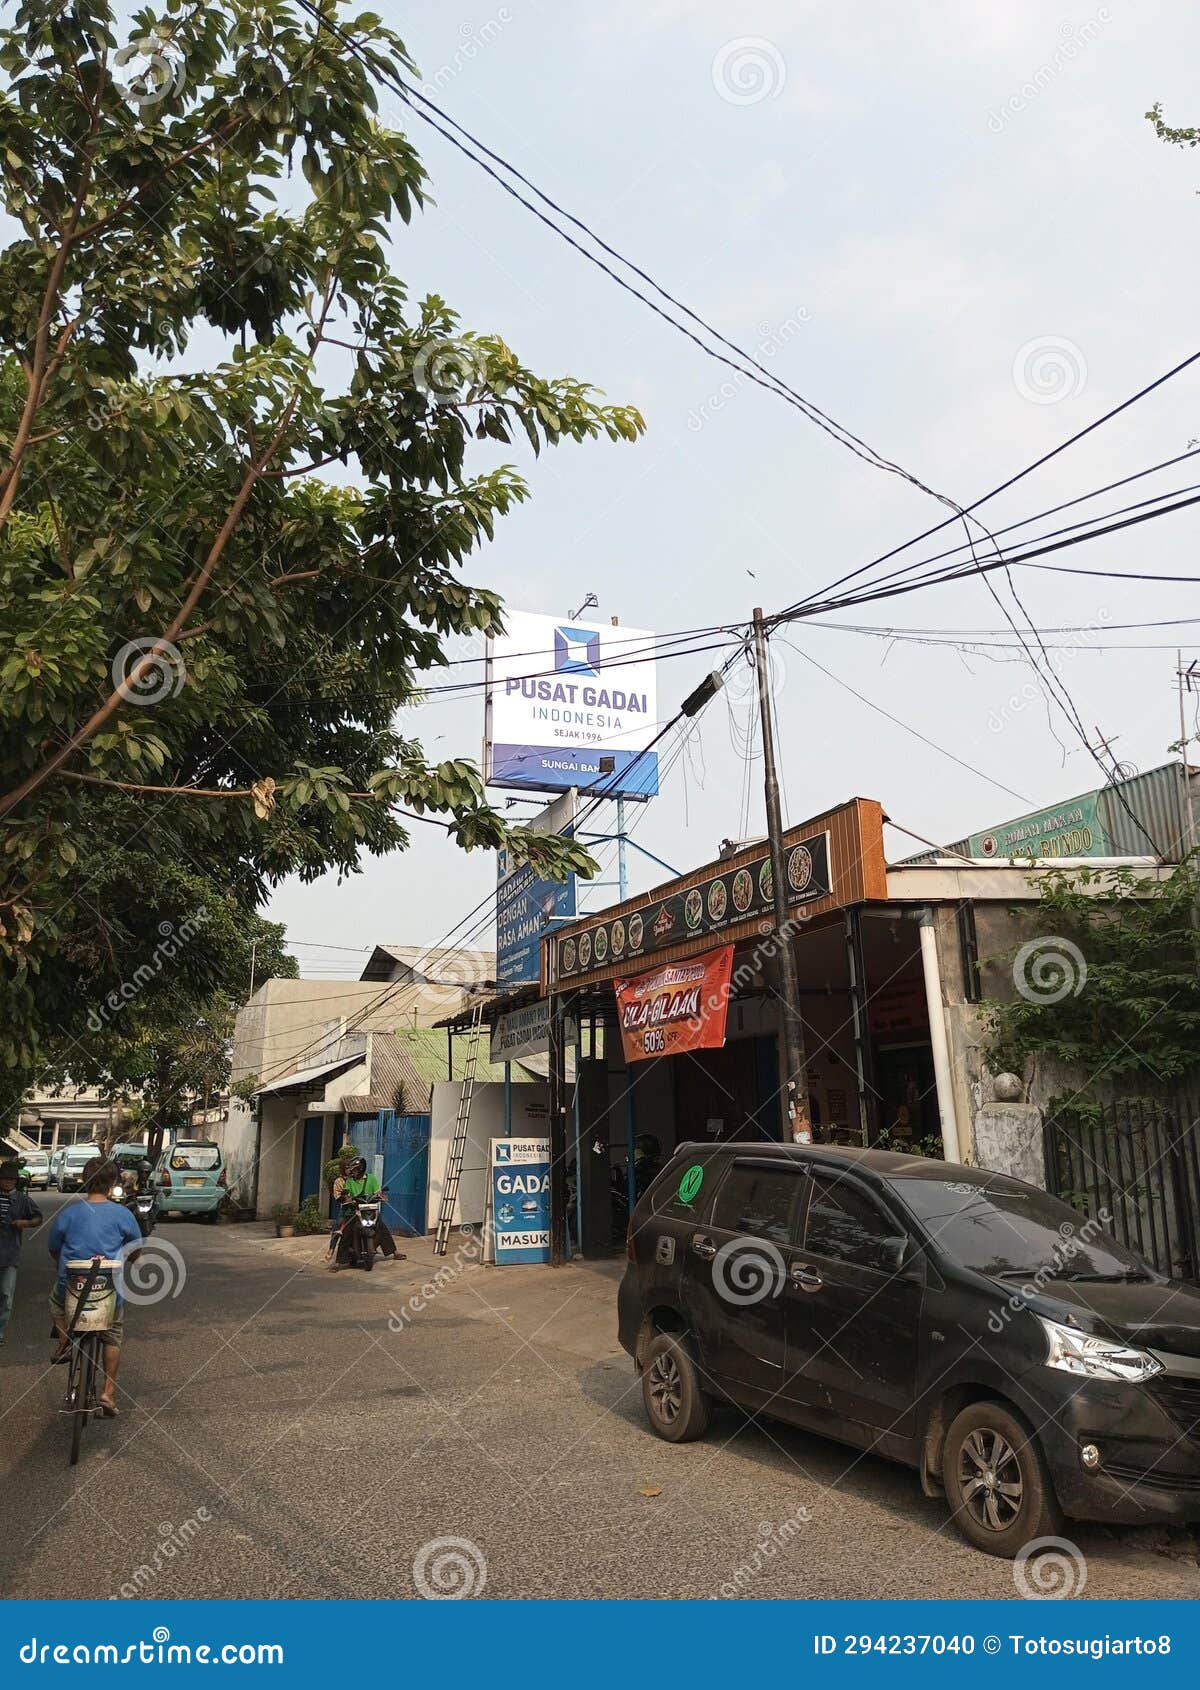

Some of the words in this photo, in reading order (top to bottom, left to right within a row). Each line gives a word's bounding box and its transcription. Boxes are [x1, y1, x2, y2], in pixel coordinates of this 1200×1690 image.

[506, 676, 578, 704] PUSAT
[583, 686, 647, 713] GADAI
[533, 706, 622, 730] INDONESIA
[554, 729, 580, 739] SEJAK
[582, 731, 602, 742] 1996
[541, 759, 578, 772] SUNGAI
[499, 897, 527, 929] DENGAN
[644, 1029, 665, 1053] 50%
[513, 1144, 535, 1153] PUSAT
[501, 1234, 548, 1246] MASUK
